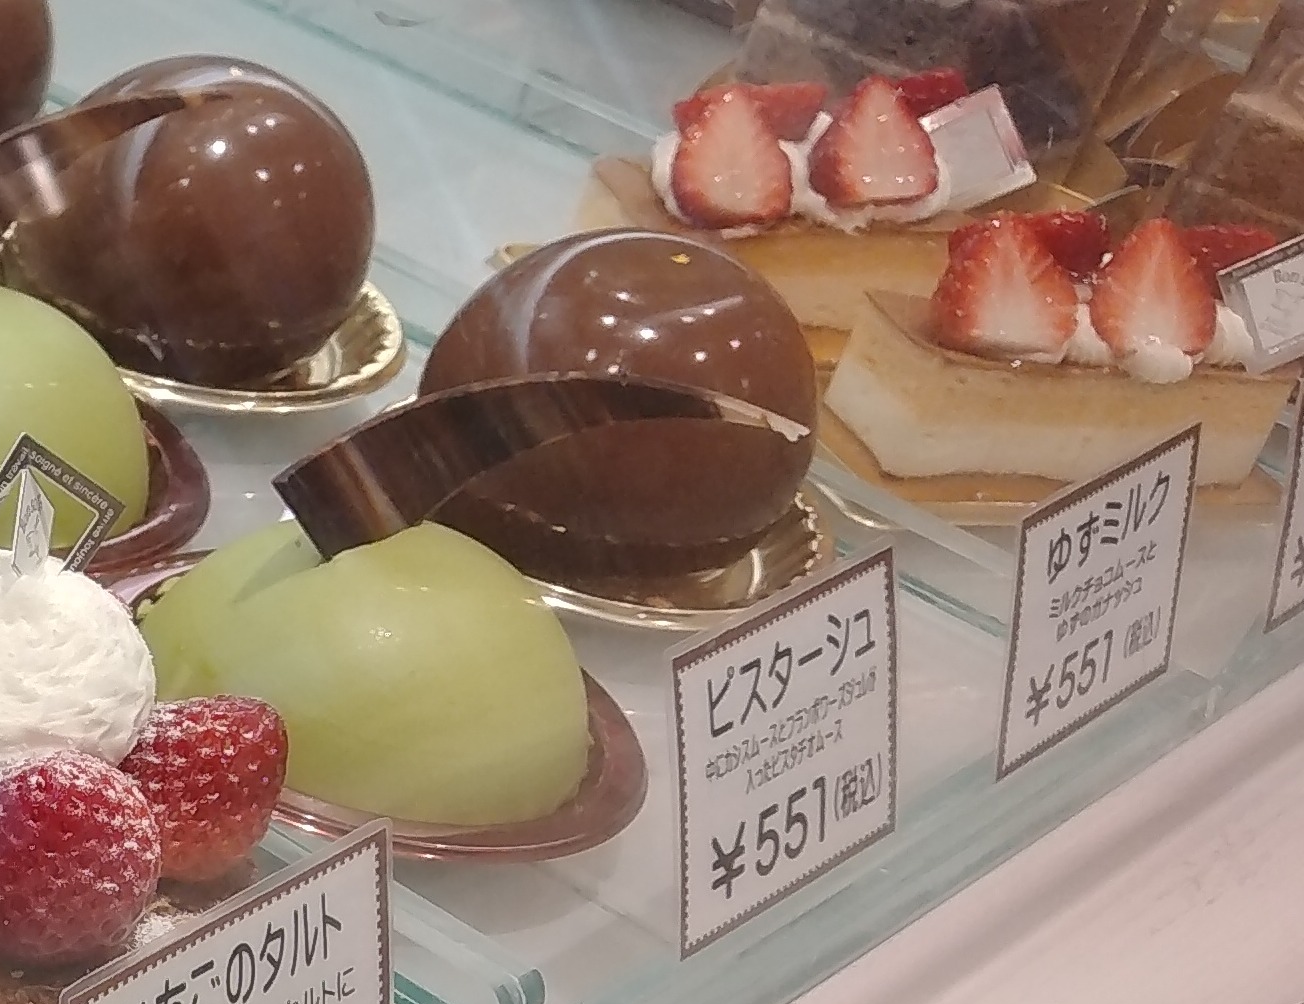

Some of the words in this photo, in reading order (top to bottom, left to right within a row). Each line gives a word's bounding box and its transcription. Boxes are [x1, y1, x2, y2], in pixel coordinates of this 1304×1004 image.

[1048, 471, 1170, 585] ゆずミルク
[708, 609, 875, 737] ピスターシュ
